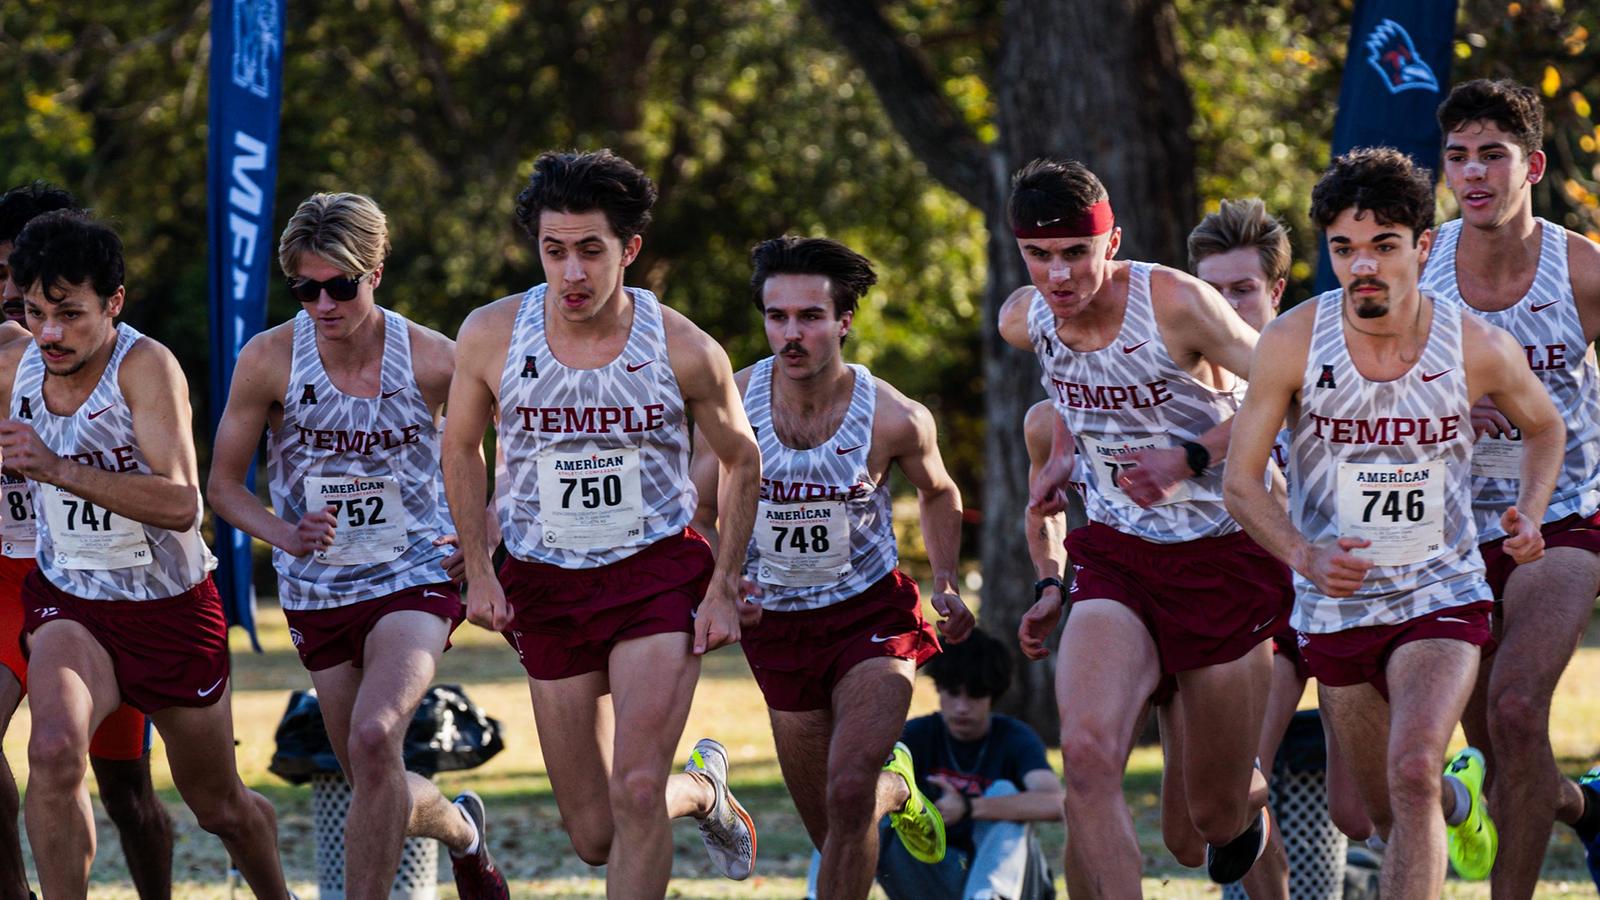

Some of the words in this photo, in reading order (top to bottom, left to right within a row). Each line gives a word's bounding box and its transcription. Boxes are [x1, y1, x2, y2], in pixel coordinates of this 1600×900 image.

[1052, 378, 1174, 410] TEMPLE
[516, 403, 665, 433] TEMPLE
[1309, 412, 1460, 446] TEMPLE
[294, 423, 421, 455] TEMPLE
[555, 454, 624, 471] AMERICAN
[1357, 468, 1430, 483] AMERICAN
[321, 479, 385, 495] AMERICAN
[559, 474, 623, 509] 750
[760, 478, 867, 502] EMPLE
[326, 496, 386, 527] 752
[766, 505, 831, 520] AMERICAN
[1362, 489, 1425, 522] 746
[771, 525, 829, 553] 748
